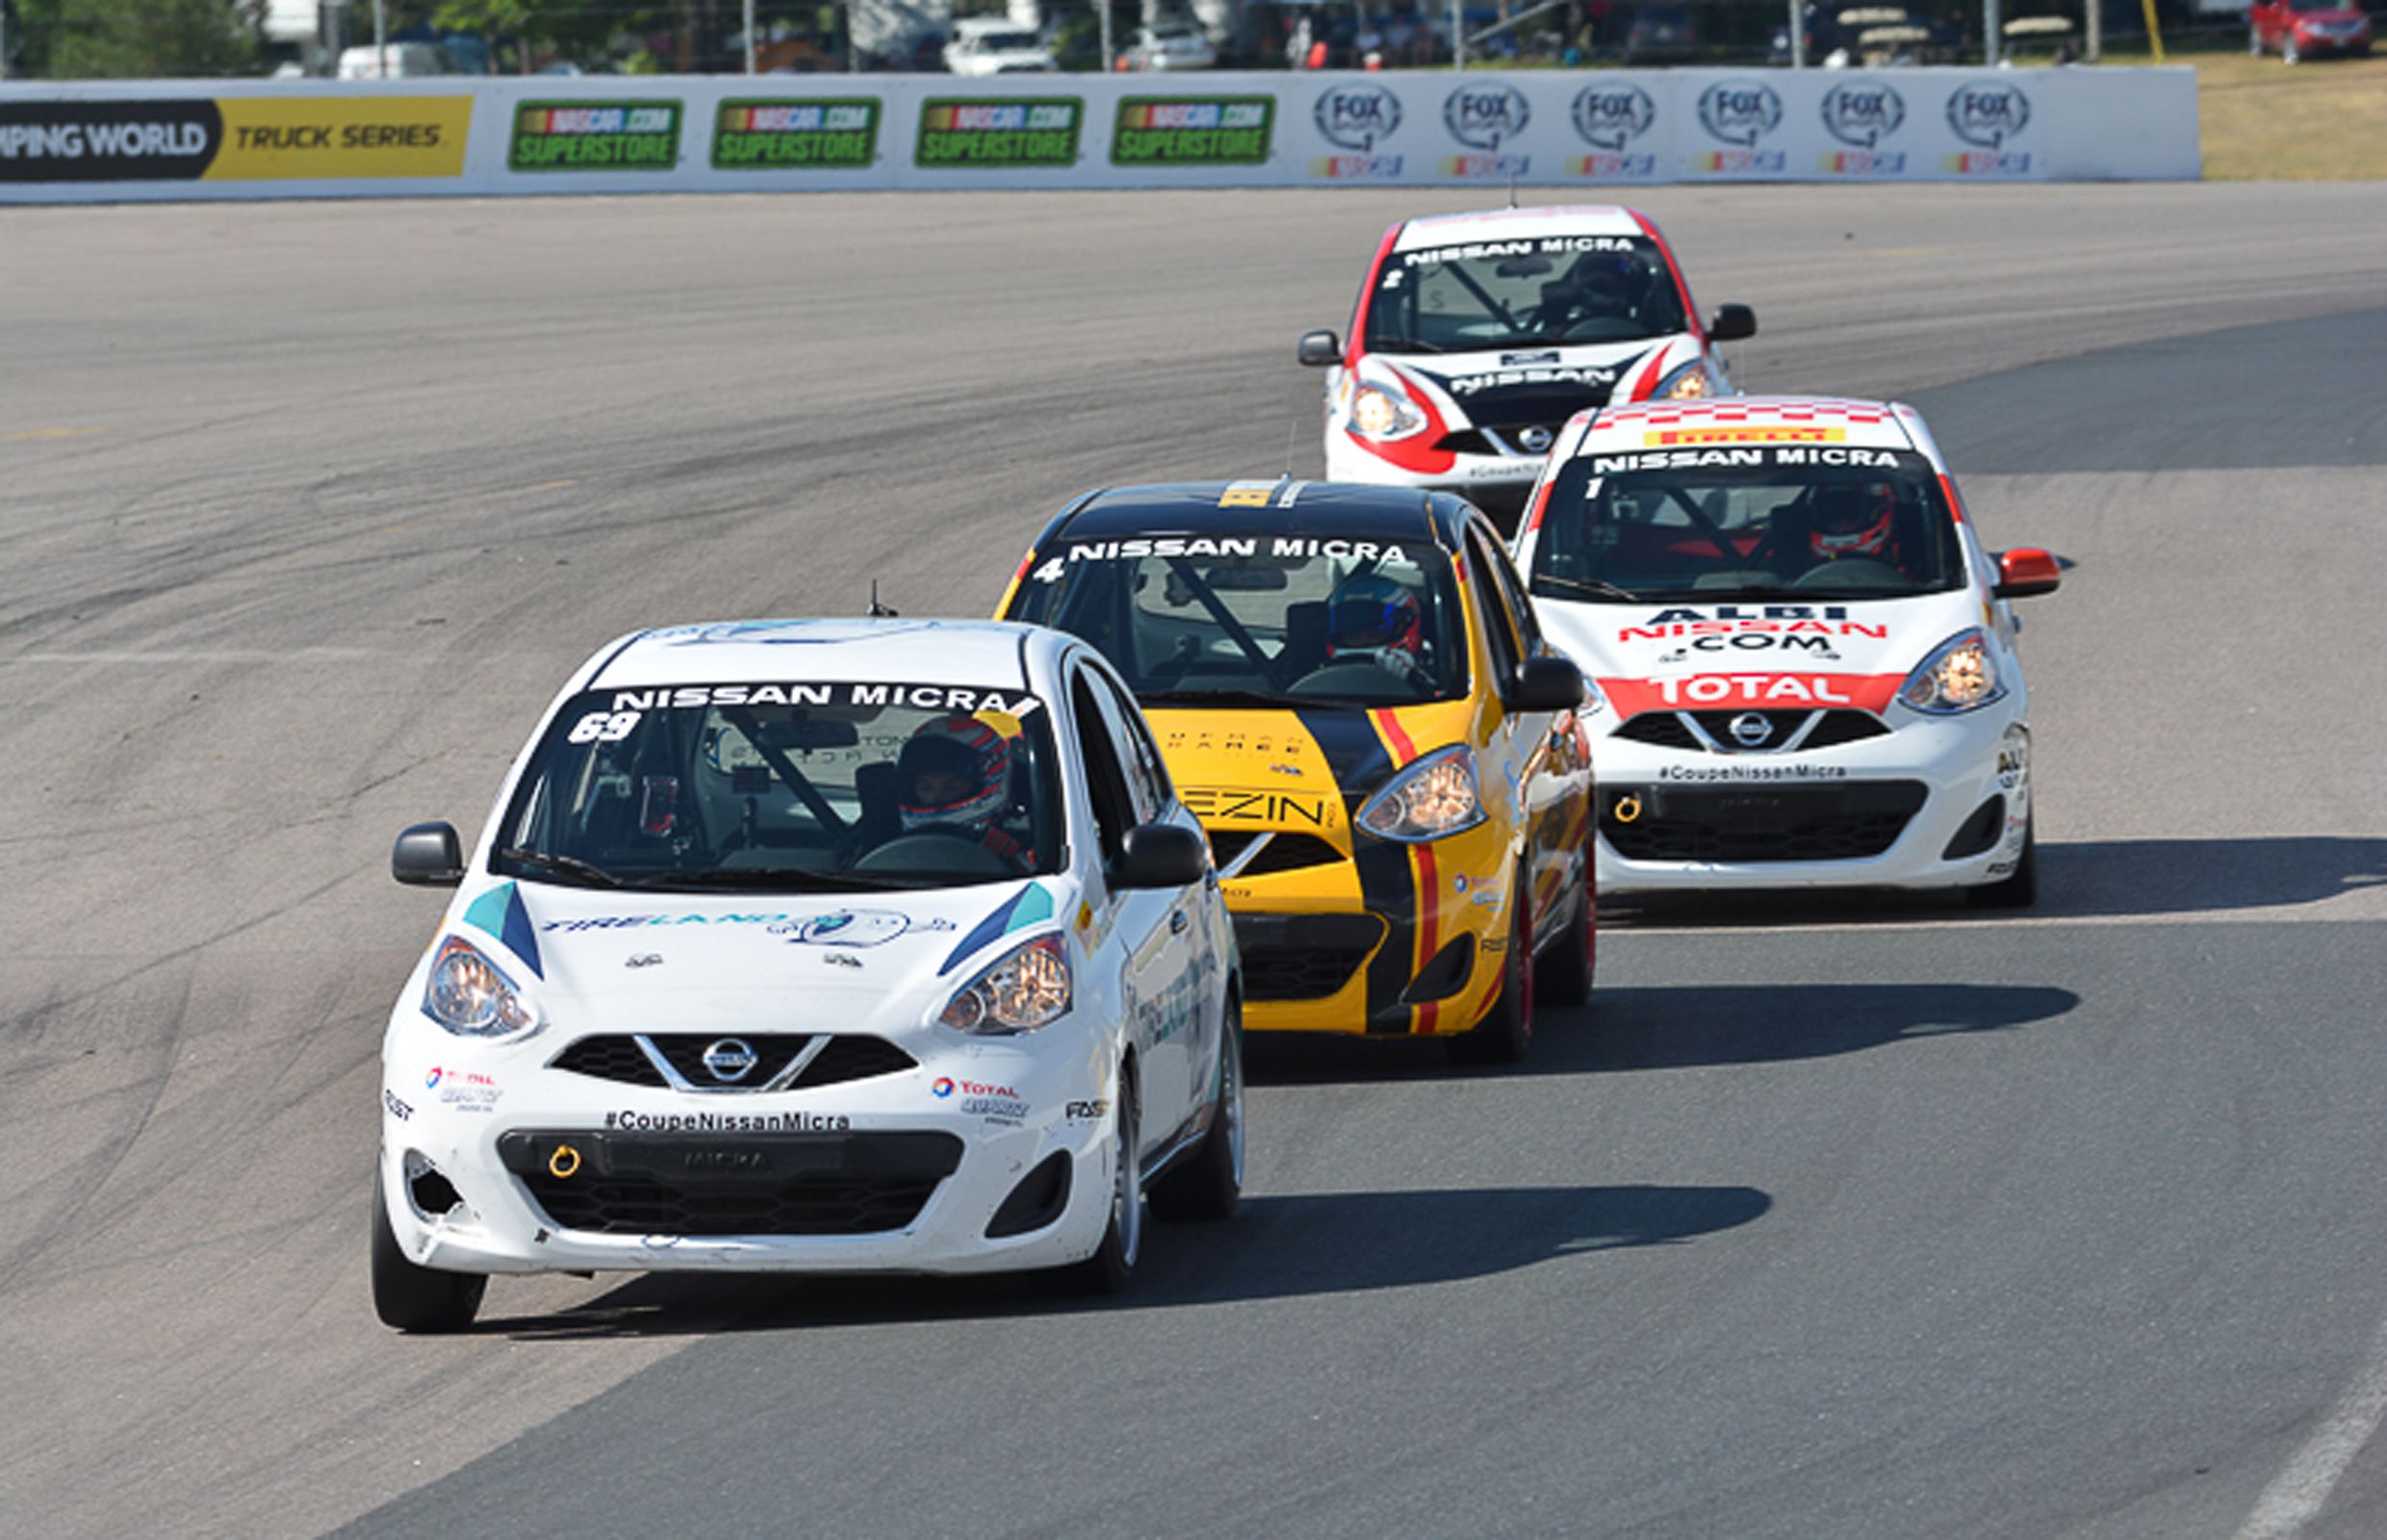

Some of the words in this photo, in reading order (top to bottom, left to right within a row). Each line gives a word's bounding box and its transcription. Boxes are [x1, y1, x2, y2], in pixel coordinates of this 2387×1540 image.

[1332, 94, 1384, 119] FOX
[1461, 93, 1510, 118] FOX
[1588, 93, 1636, 117] FOX
[1716, 90, 1764, 117] FOX
[1839, 92, 1885, 117] FOX
[1964, 92, 2012, 117] FOX
[85, 122, 207, 156] WORLD
[236, 126, 335, 149] TRUCK
[341, 123, 443, 147] SERIES
[518, 134, 672, 163] SUPERSTORE
[717, 133, 866, 161] SUPERSTORE
[923, 131, 1072, 159] SUPERSTORE
[1117, 130, 1265, 157] SUPERSTORE
[1404, 241, 1533, 267] NISSAN
[1540, 237, 1635, 252] MICRA
[1382, 269, 1404, 289] 2
[1450, 369, 1613, 396] NISSAN
[1594, 449, 1763, 475] NISSAN
[1776, 449, 1900, 468] MICRA
[1584, 477, 1605, 500] 1
[1069, 539, 1256, 562] NISSAN
[1271, 540, 1408, 563] MICRA
[1032, 556, 1065, 583] 4
[1646, 605, 1847, 626] ALBI
[1618, 620, 1887, 643] NISSAN
[1675, 632, 1831, 655] .COM
[612, 684, 834, 710] NISSAN
[851, 684, 1011, 713] MICRA
[1648, 676, 1851, 705] TOTAL
[566, 710, 643, 744] 69
[1658, 762, 1848, 783] #CoupeNissanMicra
[540, 912, 789, 933] TIRELAND
[961, 1080, 1021, 1099] TOTAL
[603, 1110, 852, 1133] #CoupeNissanMicra
